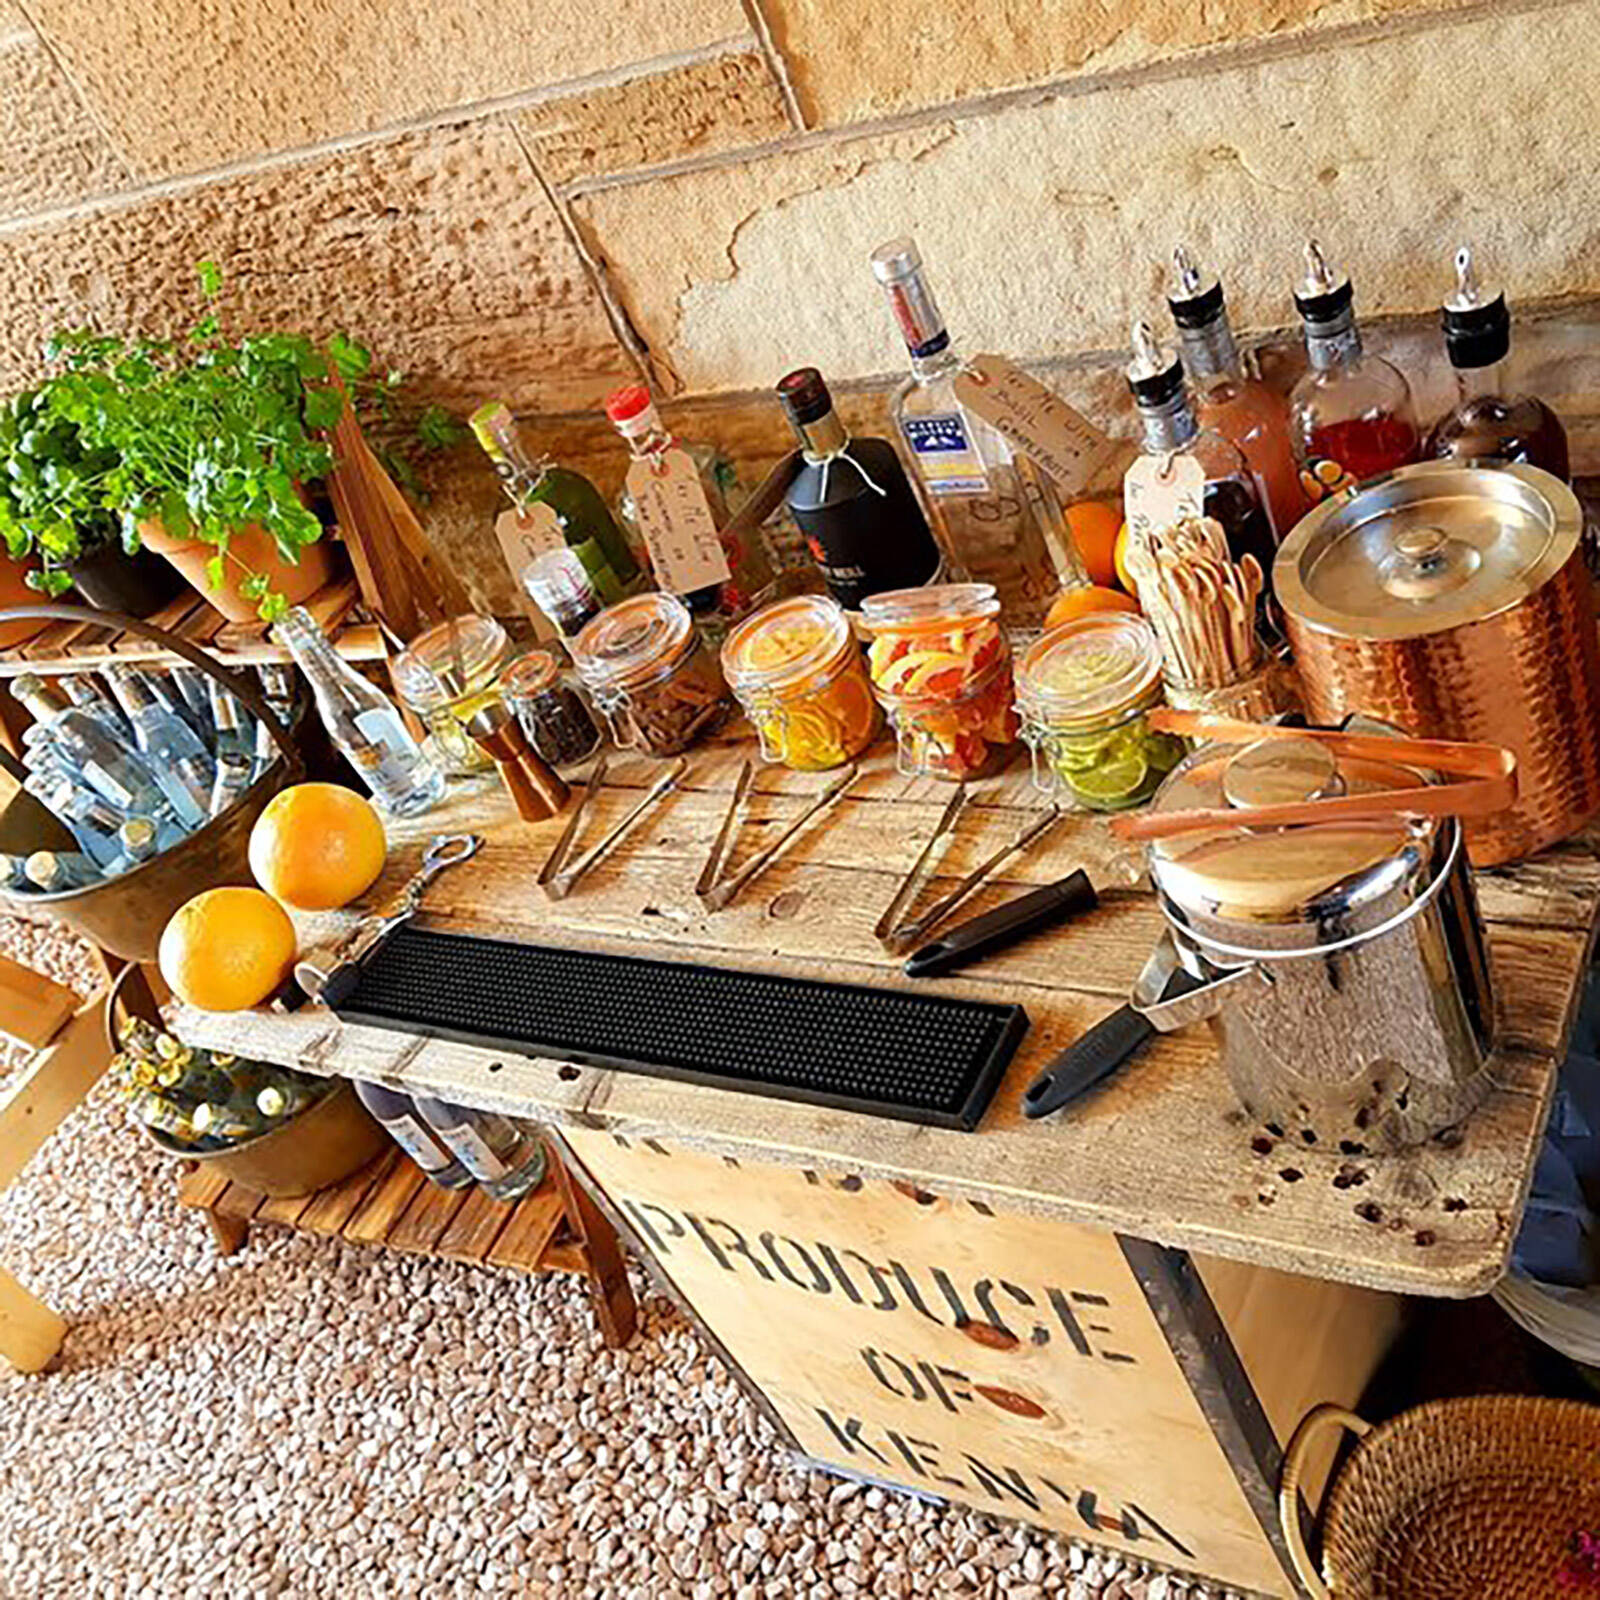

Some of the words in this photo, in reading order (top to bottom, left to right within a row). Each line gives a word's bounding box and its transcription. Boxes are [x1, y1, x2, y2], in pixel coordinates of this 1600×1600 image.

[622, 1199, 1137, 1364] PRODUCE
[859, 1345, 974, 1414] OF
[814, 1406, 1198, 1560] KENYA
